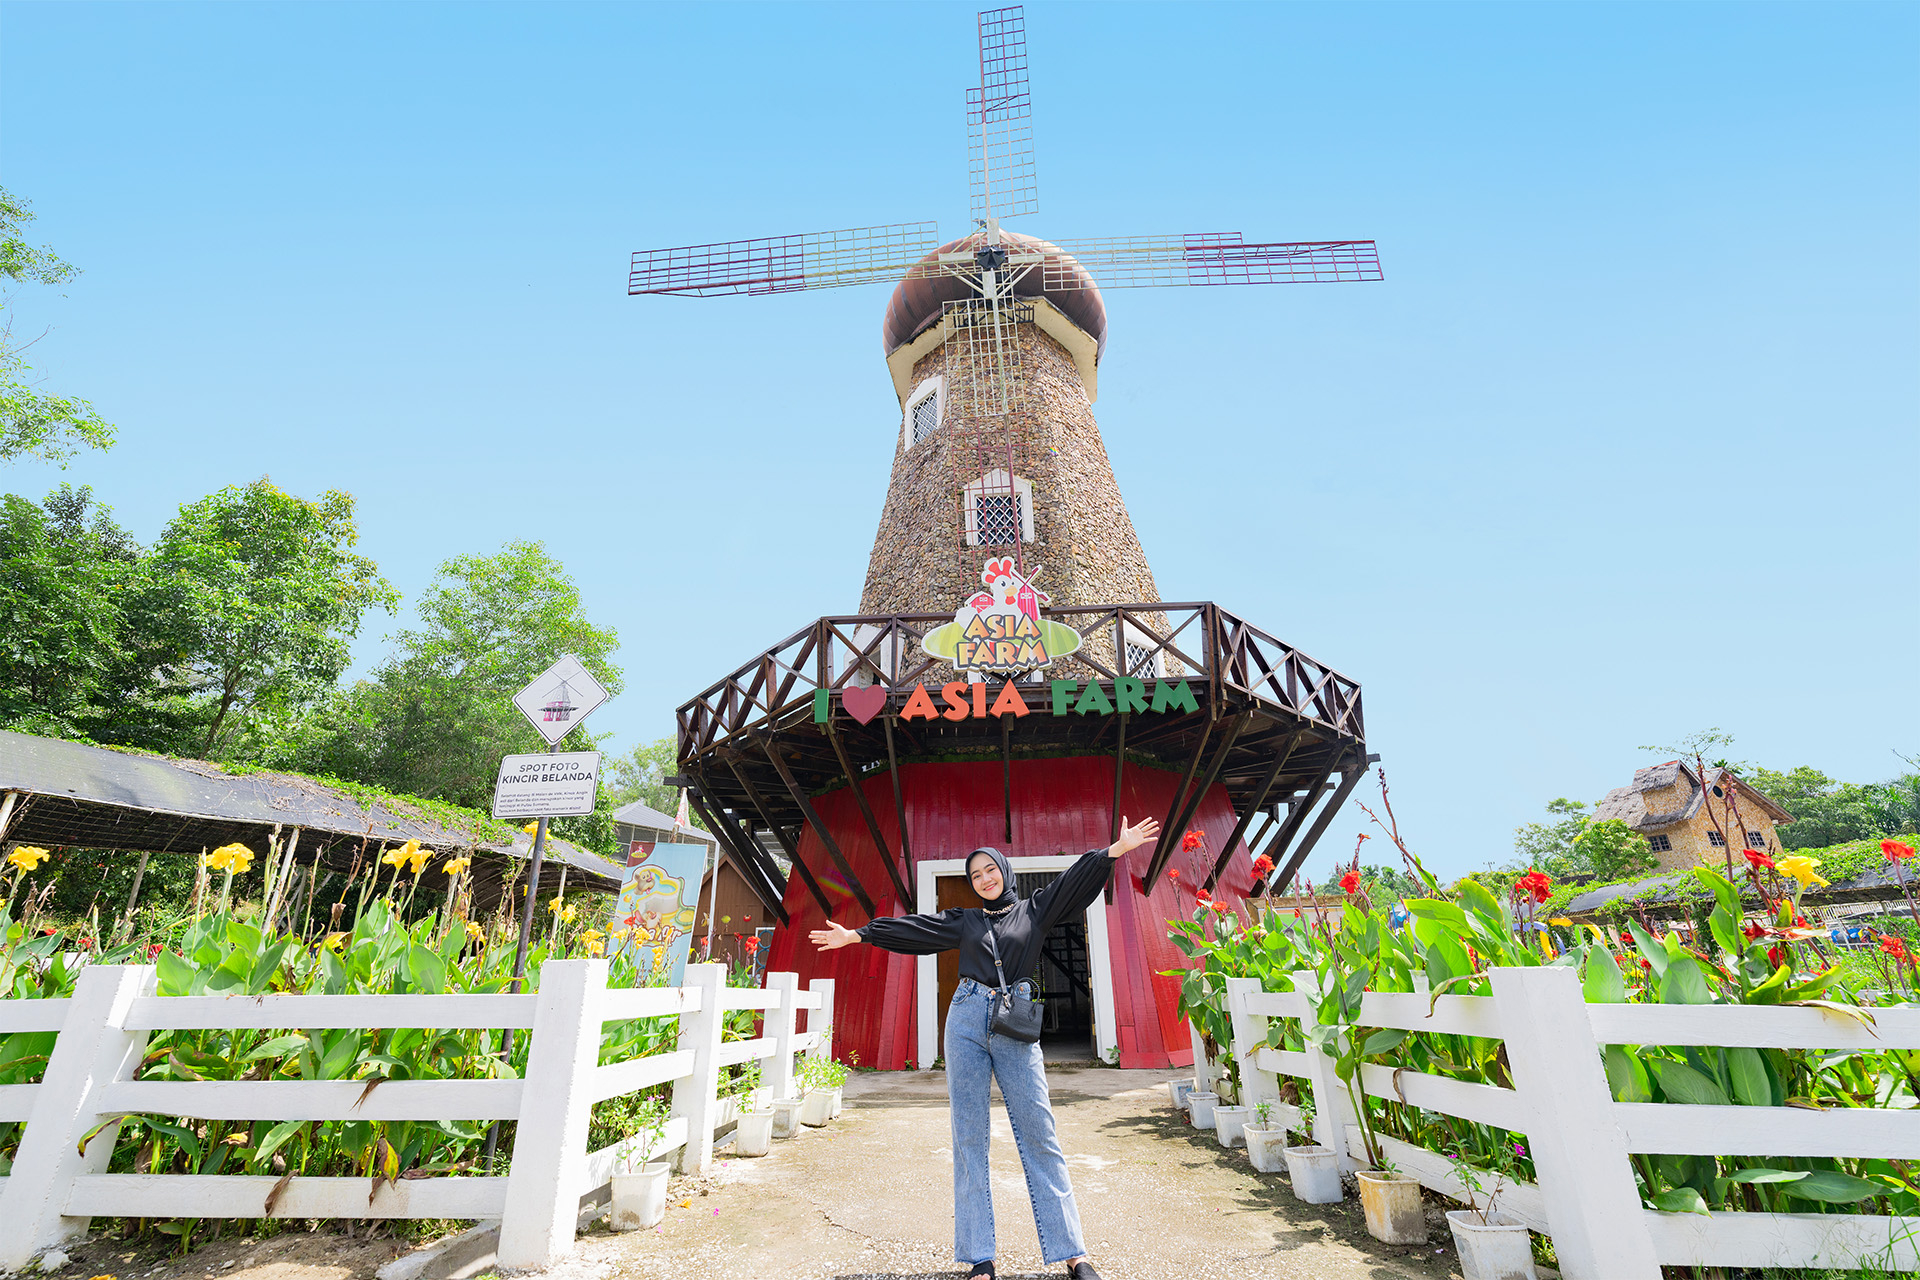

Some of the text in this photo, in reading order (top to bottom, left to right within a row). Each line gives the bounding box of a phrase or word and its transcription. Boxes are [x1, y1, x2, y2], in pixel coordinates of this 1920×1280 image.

[962, 612, 1042, 641] ASIA
[957, 639, 1049, 667] FARM
[814, 676, 1200, 724] I ASIA FARM
[502, 772, 593, 784] KINCIR BELANDA
[519, 762, 579, 773] SPOT FOTO
